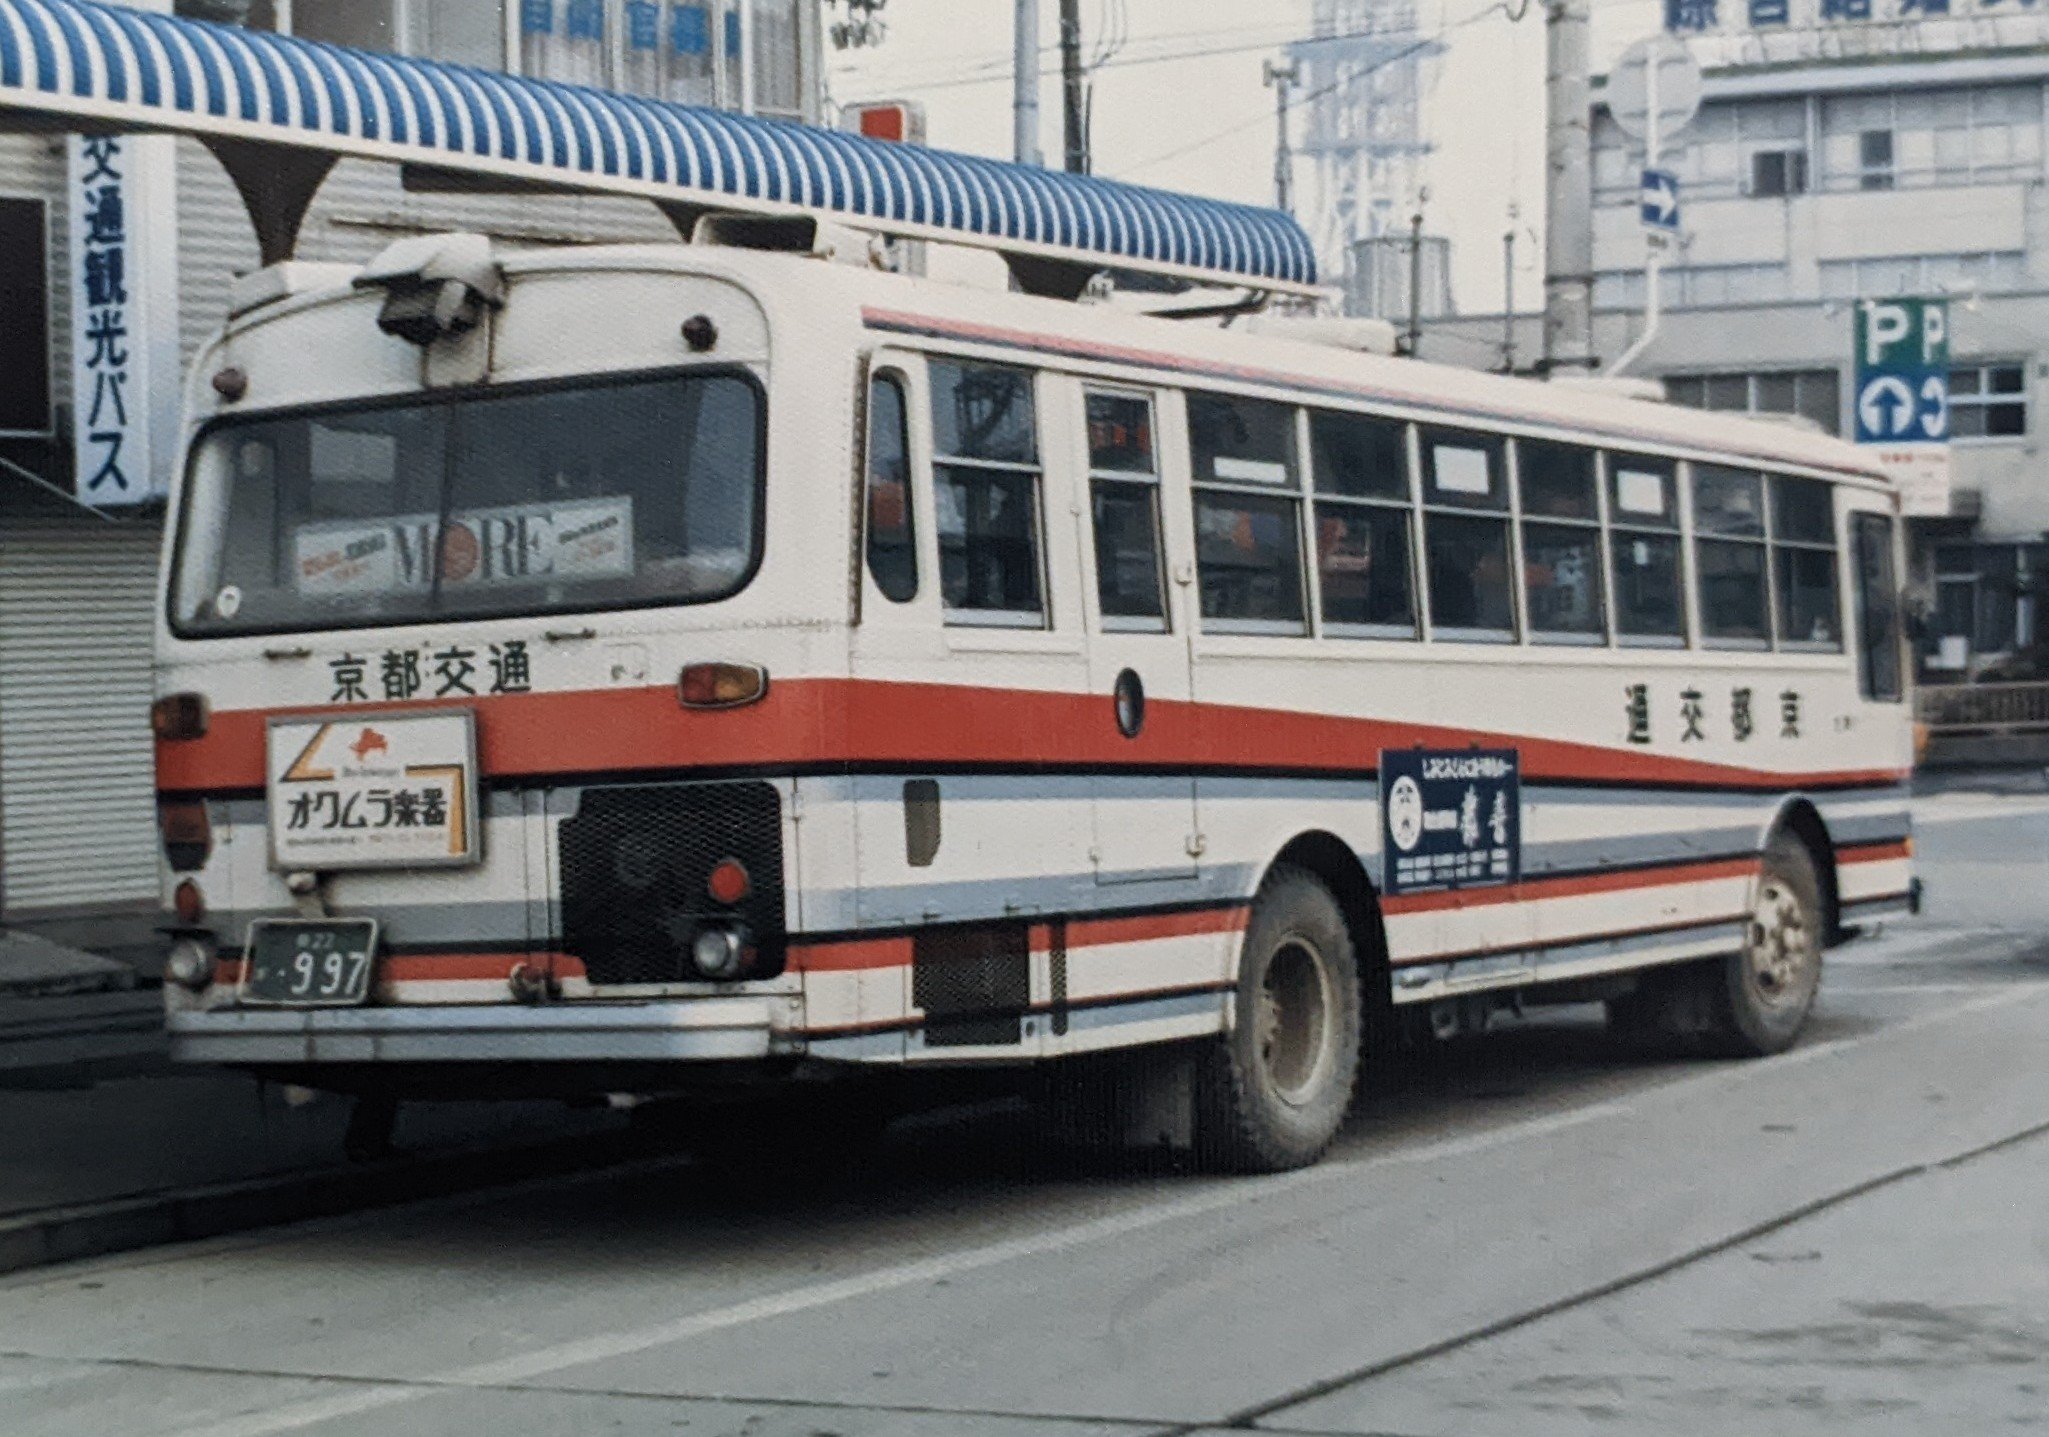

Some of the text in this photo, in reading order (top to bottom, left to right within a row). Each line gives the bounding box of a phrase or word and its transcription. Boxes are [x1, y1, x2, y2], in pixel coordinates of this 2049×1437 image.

[1867, 303, 1909, 365] P
[329, 640, 532, 701] 京都交通
